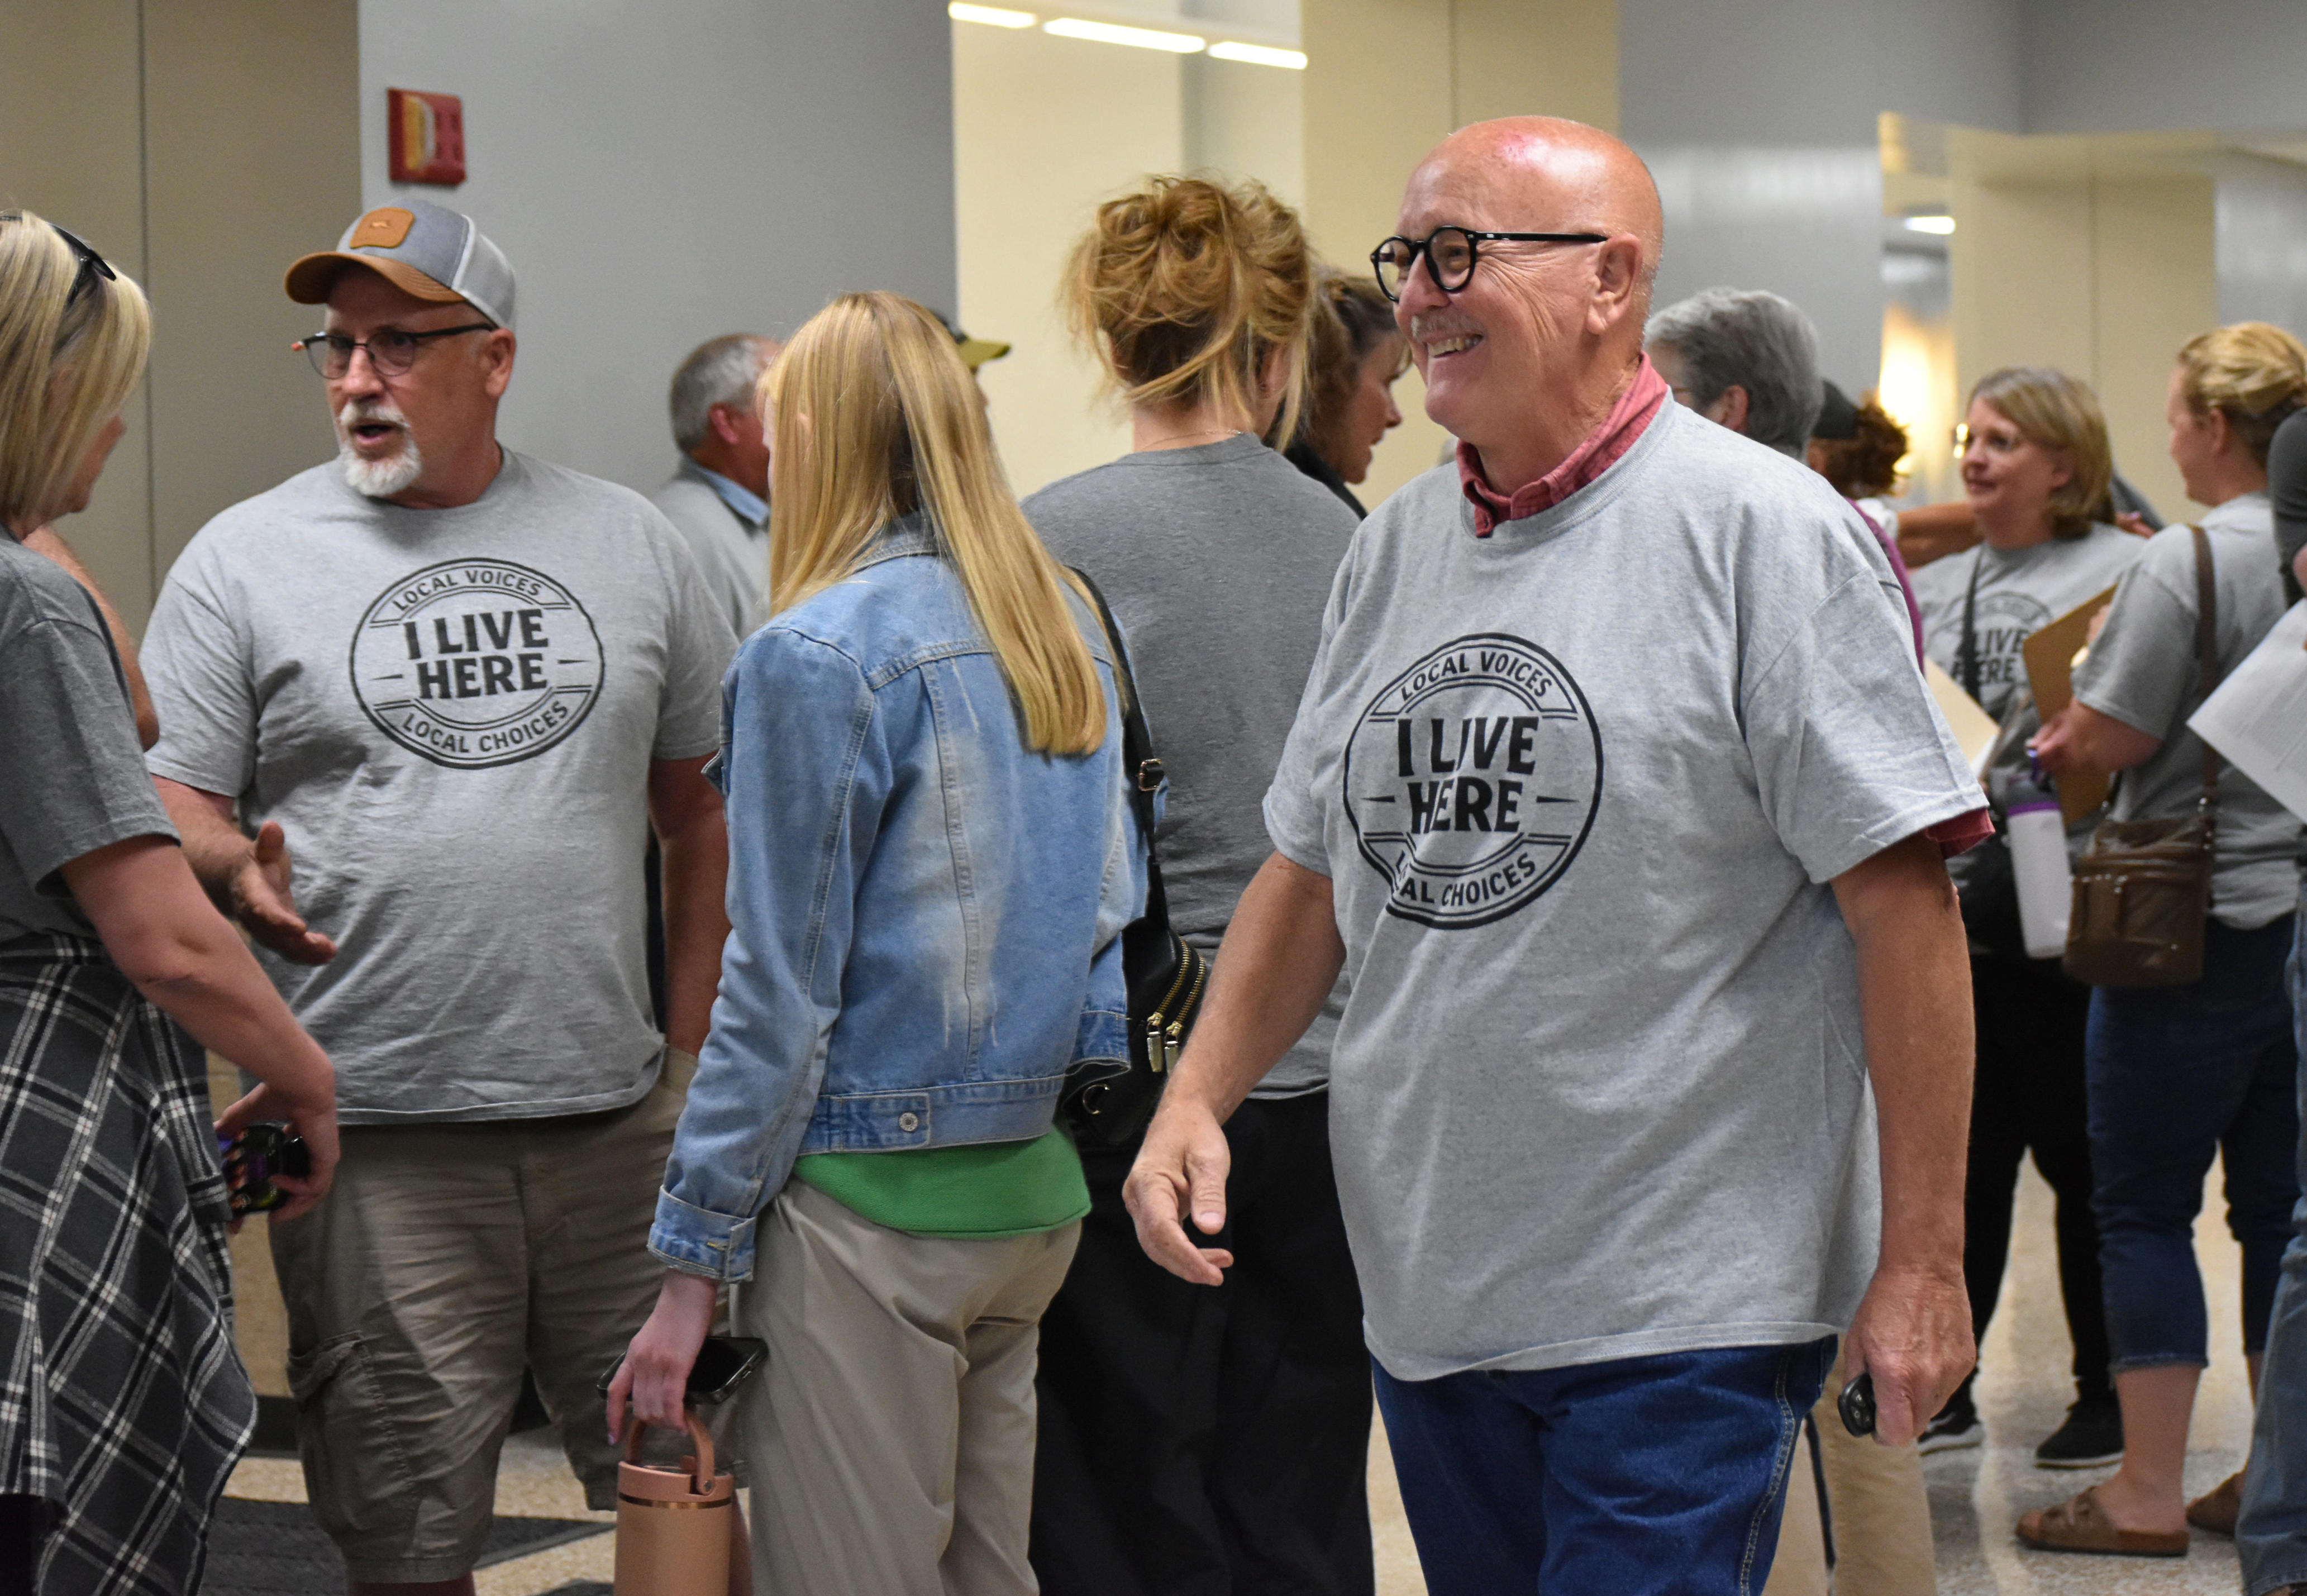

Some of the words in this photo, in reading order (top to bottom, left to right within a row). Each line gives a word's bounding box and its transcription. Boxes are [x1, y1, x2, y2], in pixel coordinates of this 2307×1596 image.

[393, 573, 458, 611] LOCAL
[465, 570, 542, 597] VOICES
[403, 621, 421, 660] I
[434, 608, 549, 654] LIVE
[416, 652, 547, 699] HERE
[1401, 653, 1470, 702] LOCAL
[1480, 651, 1552, 697] VOICES
[402, 712, 470, 753] LOCAL
[478, 700, 568, 752] CHOICES
[1398, 718, 1414, 776] I
[1431, 716, 1539, 775] LIVE
[1407, 776, 1523, 834] HERE
[1396, 849, 1434, 904] LAL
[1441, 852, 1536, 907] CHOICES
